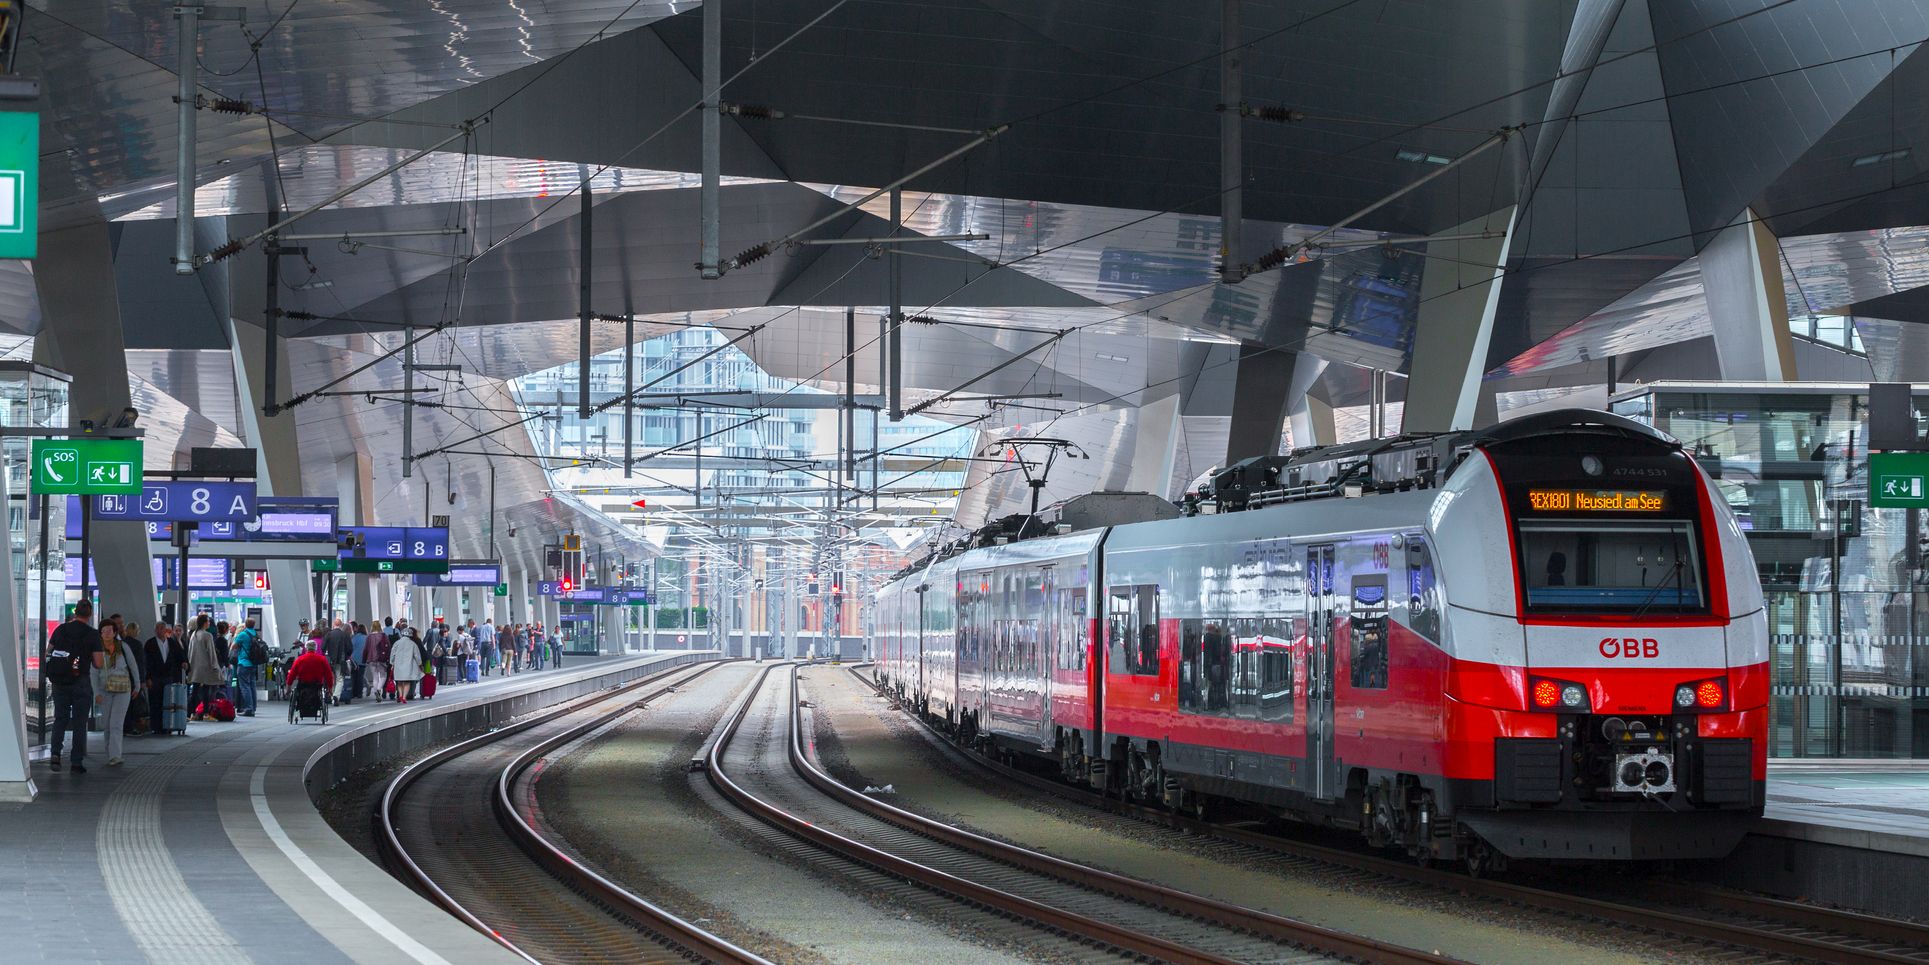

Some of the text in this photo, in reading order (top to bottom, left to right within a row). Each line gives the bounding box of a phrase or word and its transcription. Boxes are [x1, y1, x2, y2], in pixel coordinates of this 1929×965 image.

[54, 452, 75, 462] SOS
[1613, 468, 1668, 477] 4744 531
[191, 488, 248, 515] 8 A
[1576, 493, 1622, 509] Neusiedl
[1624, 496, 1639, 509] am
[1639, 493, 1661, 509] See
[435, 515, 447, 526] 70
[149, 522, 157, 533] 8
[414, 541, 443, 556] 8 B
[543, 584, 550, 593] 8
[612, 595, 618, 603] 8
[1599, 637, 1660, 658] ÖBB
